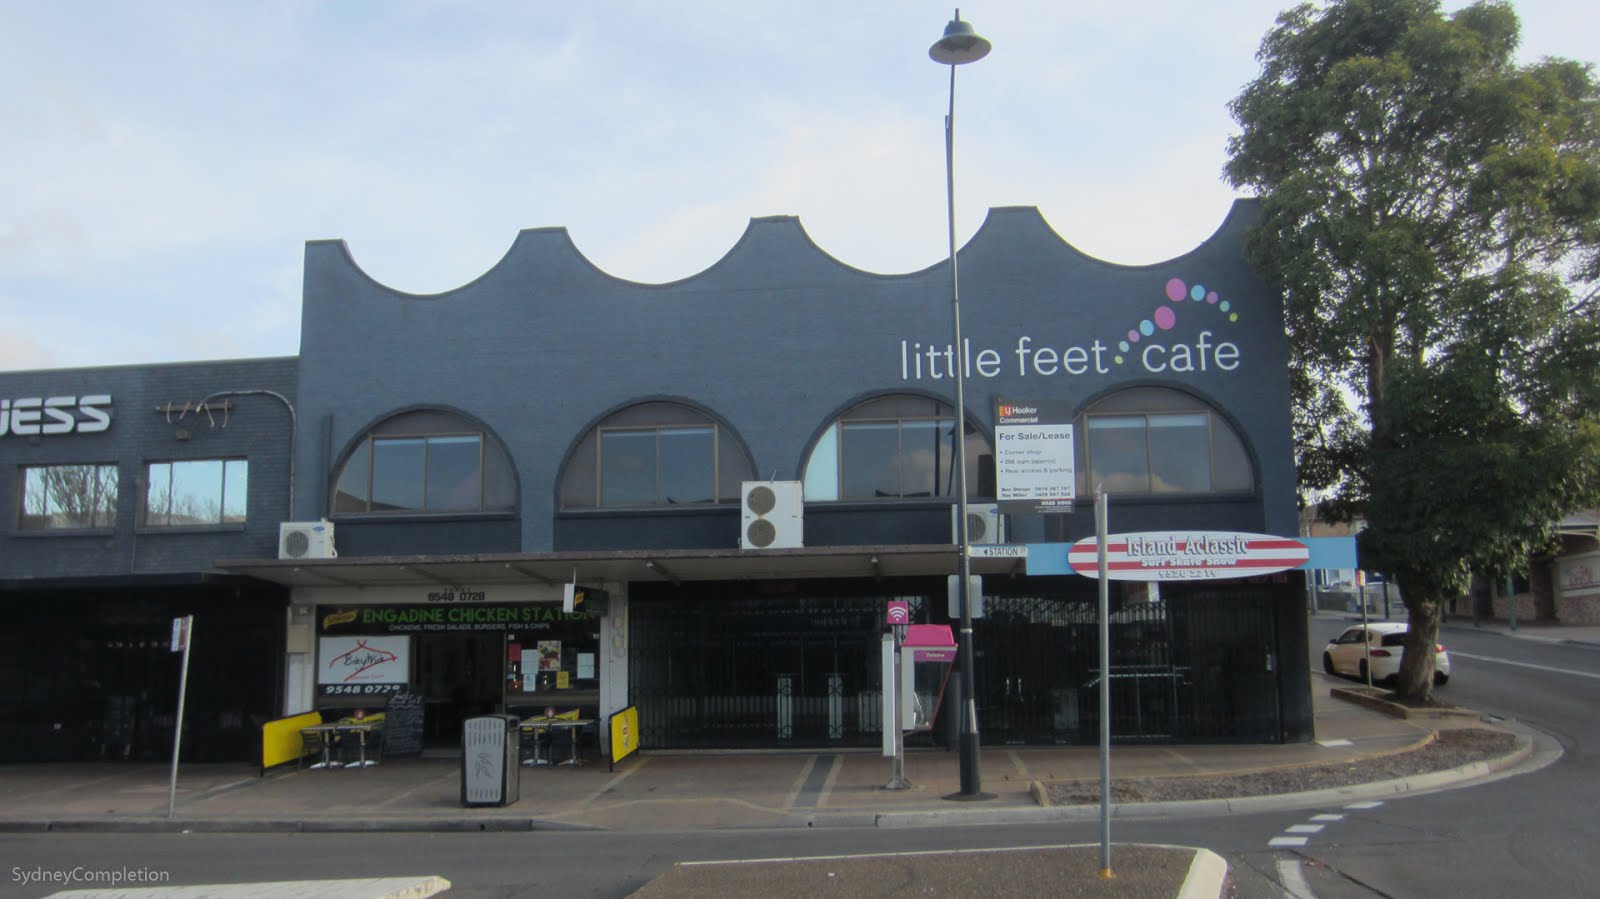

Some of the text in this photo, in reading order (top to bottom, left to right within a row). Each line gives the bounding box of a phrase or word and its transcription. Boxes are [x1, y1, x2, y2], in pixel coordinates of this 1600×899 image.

[901, 331, 1240, 380] little feet cafe
[1012, 406, 1037, 414] Hooker
[999, 416, 1039, 424] Commercial
[999, 431, 1071, 441] For Sale/Lease
[1030, 458, 1057, 466] (approx)
[1049, 466, 1073, 475] parking
[1125, 534, 1249, 556] Island Aclassic
[988, 547, 1018, 557] STATION
[1141, 556, 1237, 567] Surf Skate Snow
[427, 591, 486, 602] 9548 0728
[362, 608, 444, 624] ENGADINE
[447, 607, 518, 623] CHICKEN
[423, 623, 446, 631] FRESH
[508, 622, 525, 630] FISH
[529, 622, 551, 630] CHIPS
[325, 685, 361, 695] 9548
